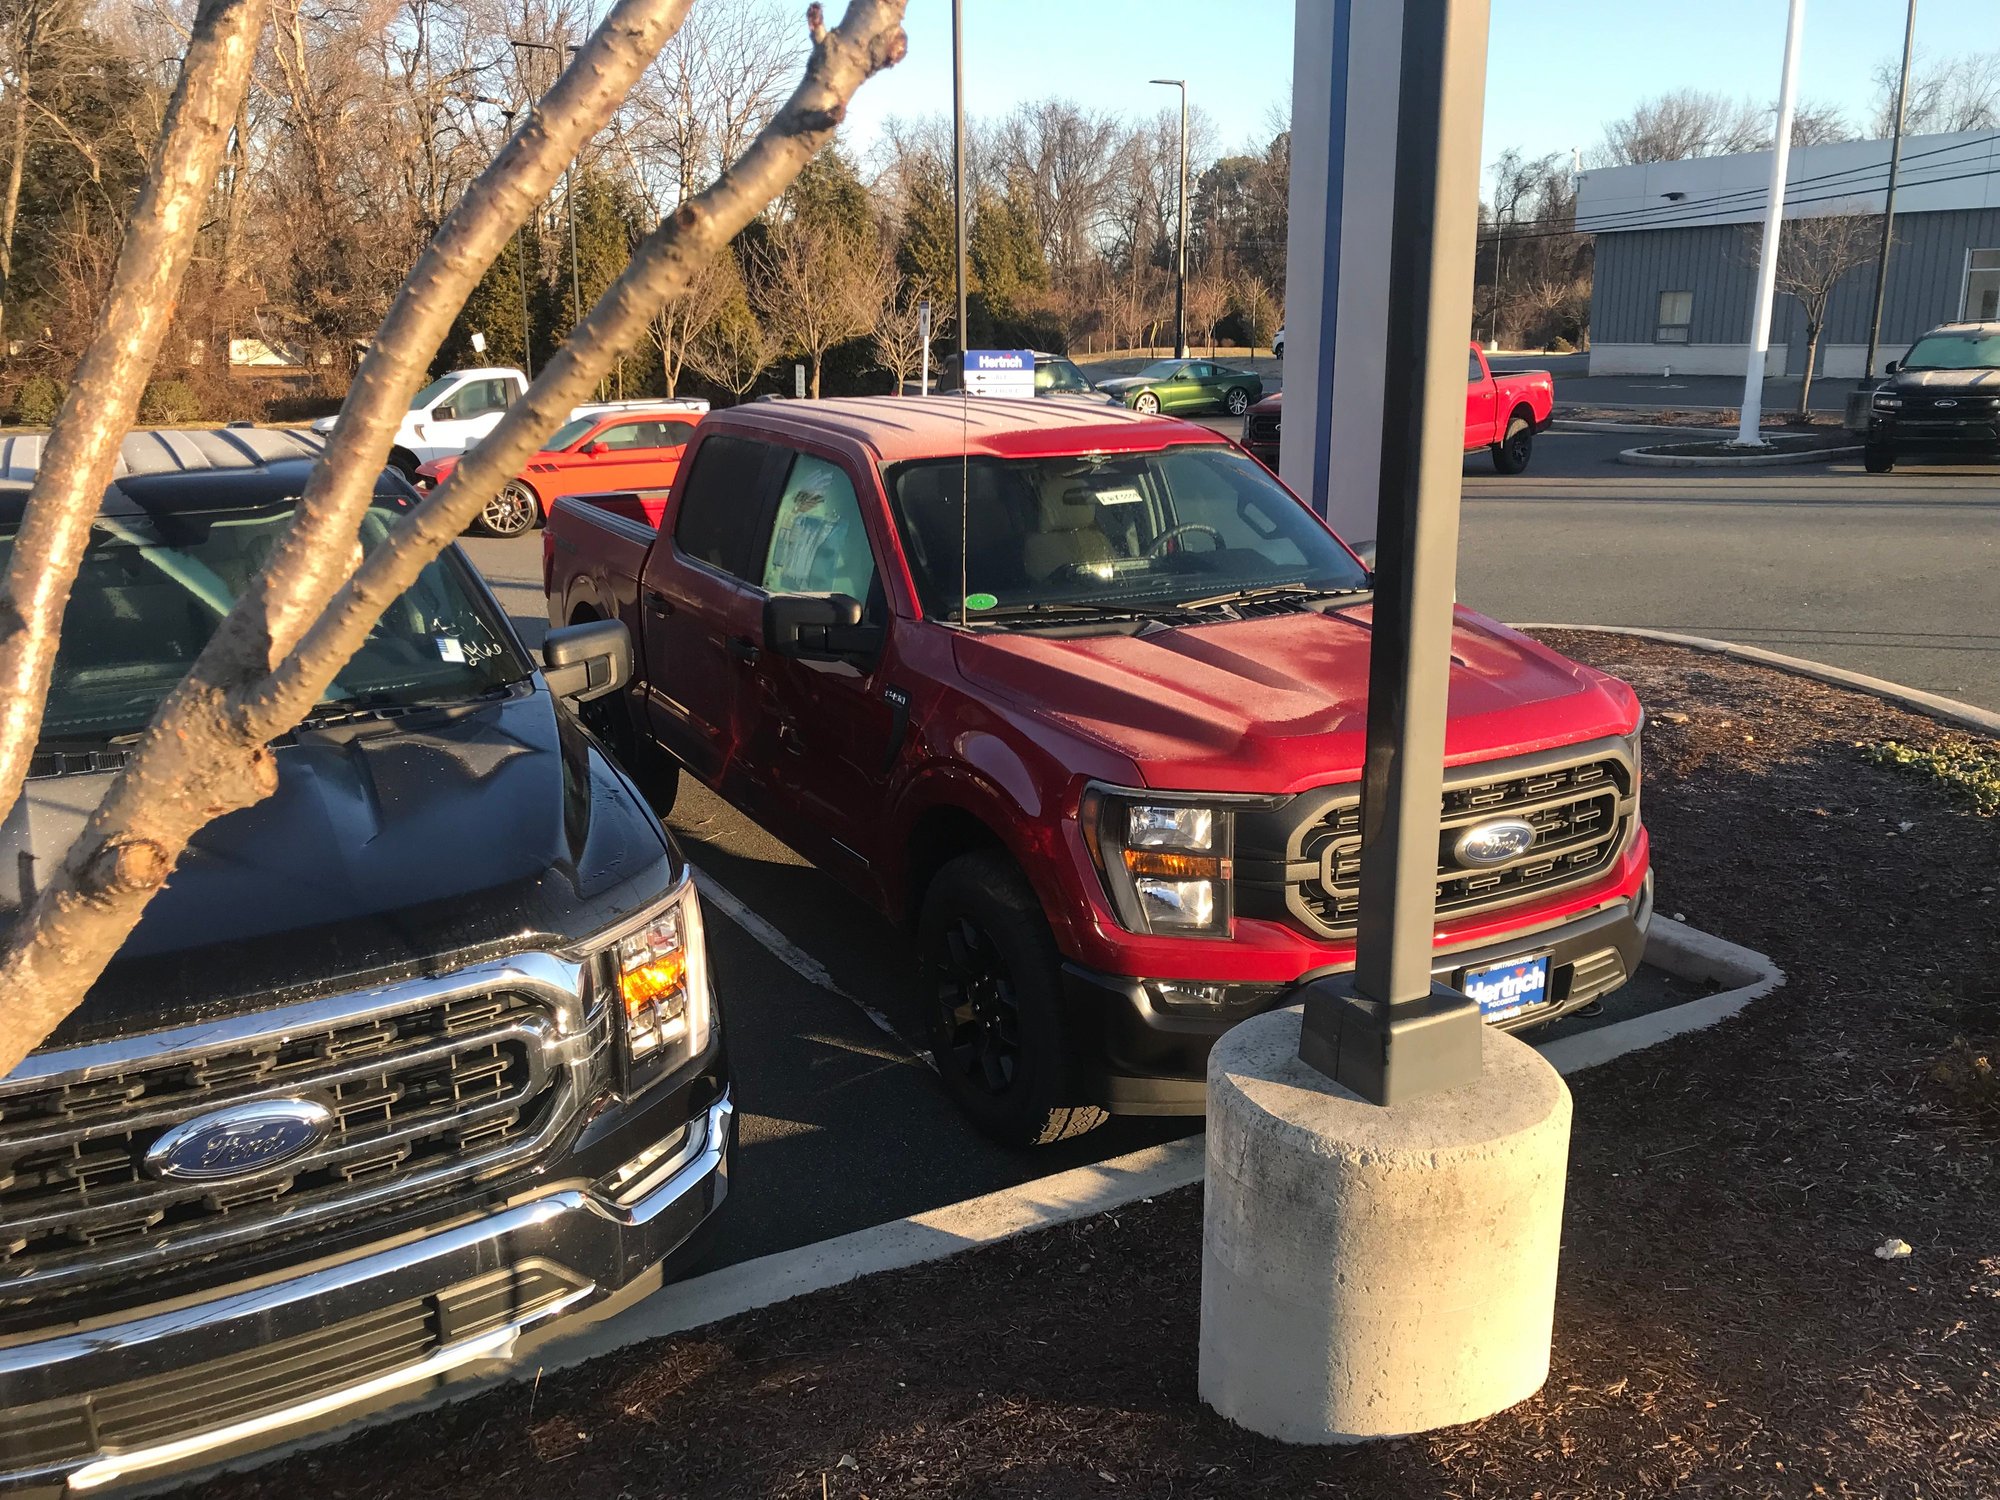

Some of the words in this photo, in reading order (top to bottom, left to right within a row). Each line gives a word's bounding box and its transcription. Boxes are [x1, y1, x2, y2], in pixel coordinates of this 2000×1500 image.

[979, 354, 1022, 368] Hertrich
[1481, 832, 1521, 856] Ford
[1465, 966, 1546, 1004] Hertrich
[200, 1125, 286, 1168] Ford
